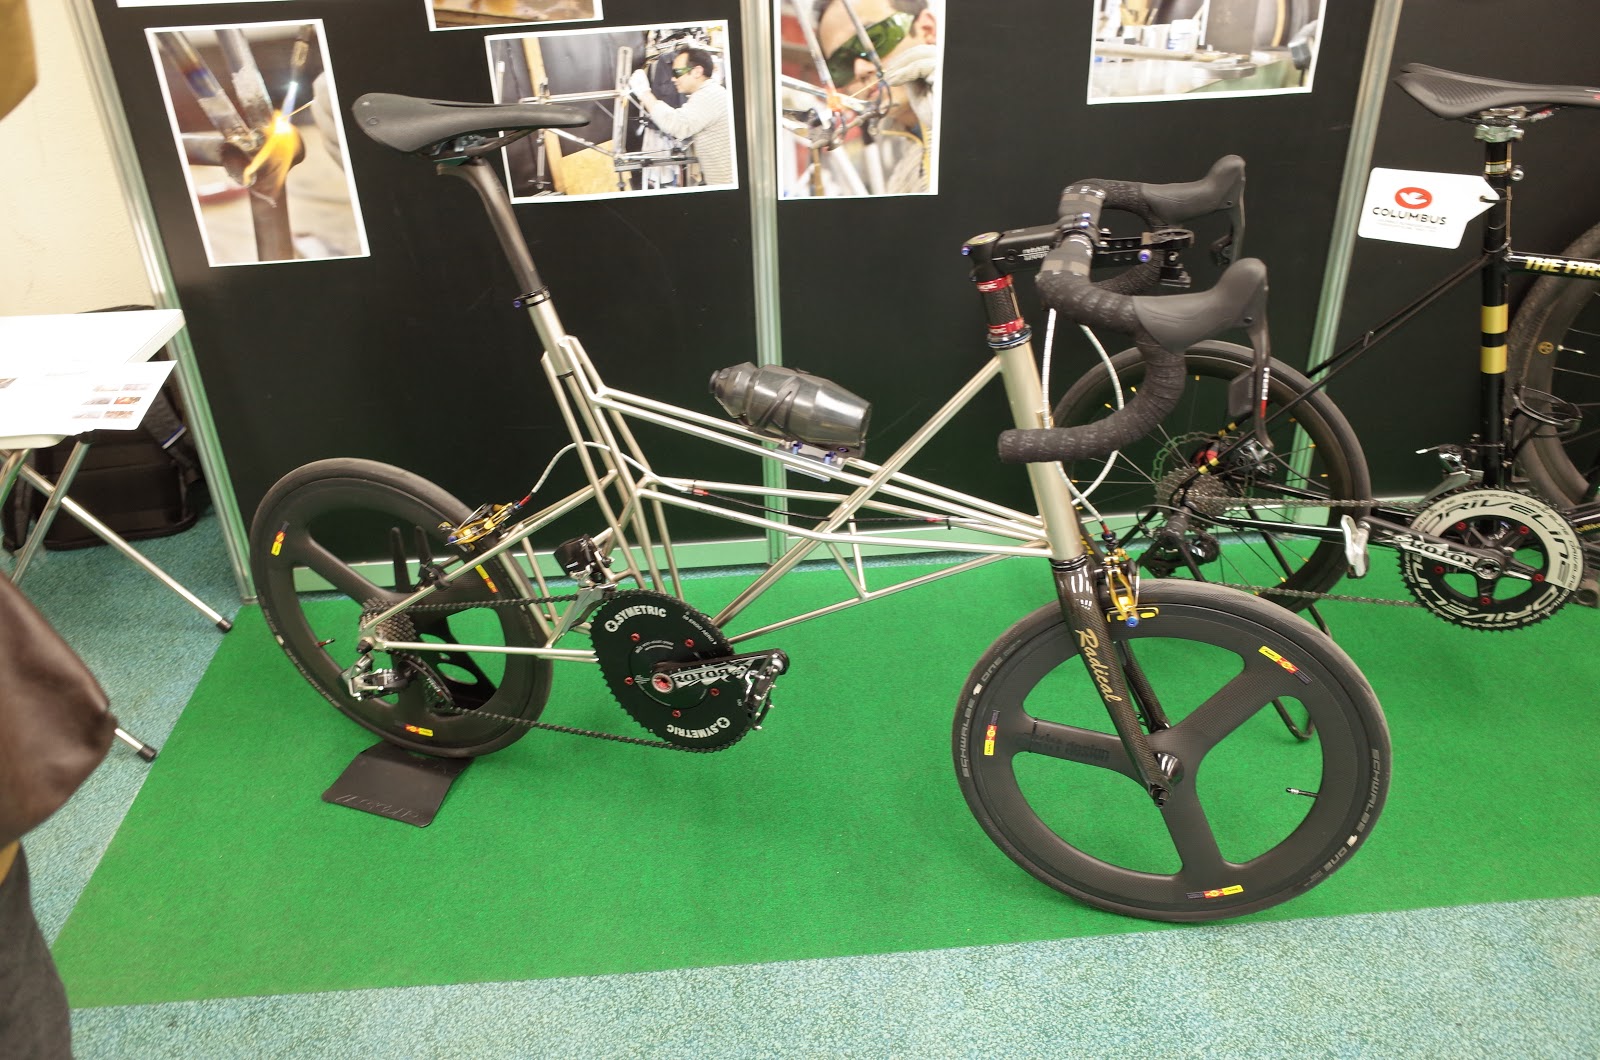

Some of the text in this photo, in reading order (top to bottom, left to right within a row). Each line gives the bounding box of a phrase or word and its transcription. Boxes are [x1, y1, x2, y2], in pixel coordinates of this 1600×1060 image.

[1372, 206, 1447, 225] COLUMBUS
[1524, 256, 1563, 273] THE
[671, 668, 729, 683] ROTOR
[1075, 628, 1122, 702] Radical
[959, 656, 1003, 778] SCHWALBE ONE
[1323, 748, 1381, 871] SCHWALBE ONE
